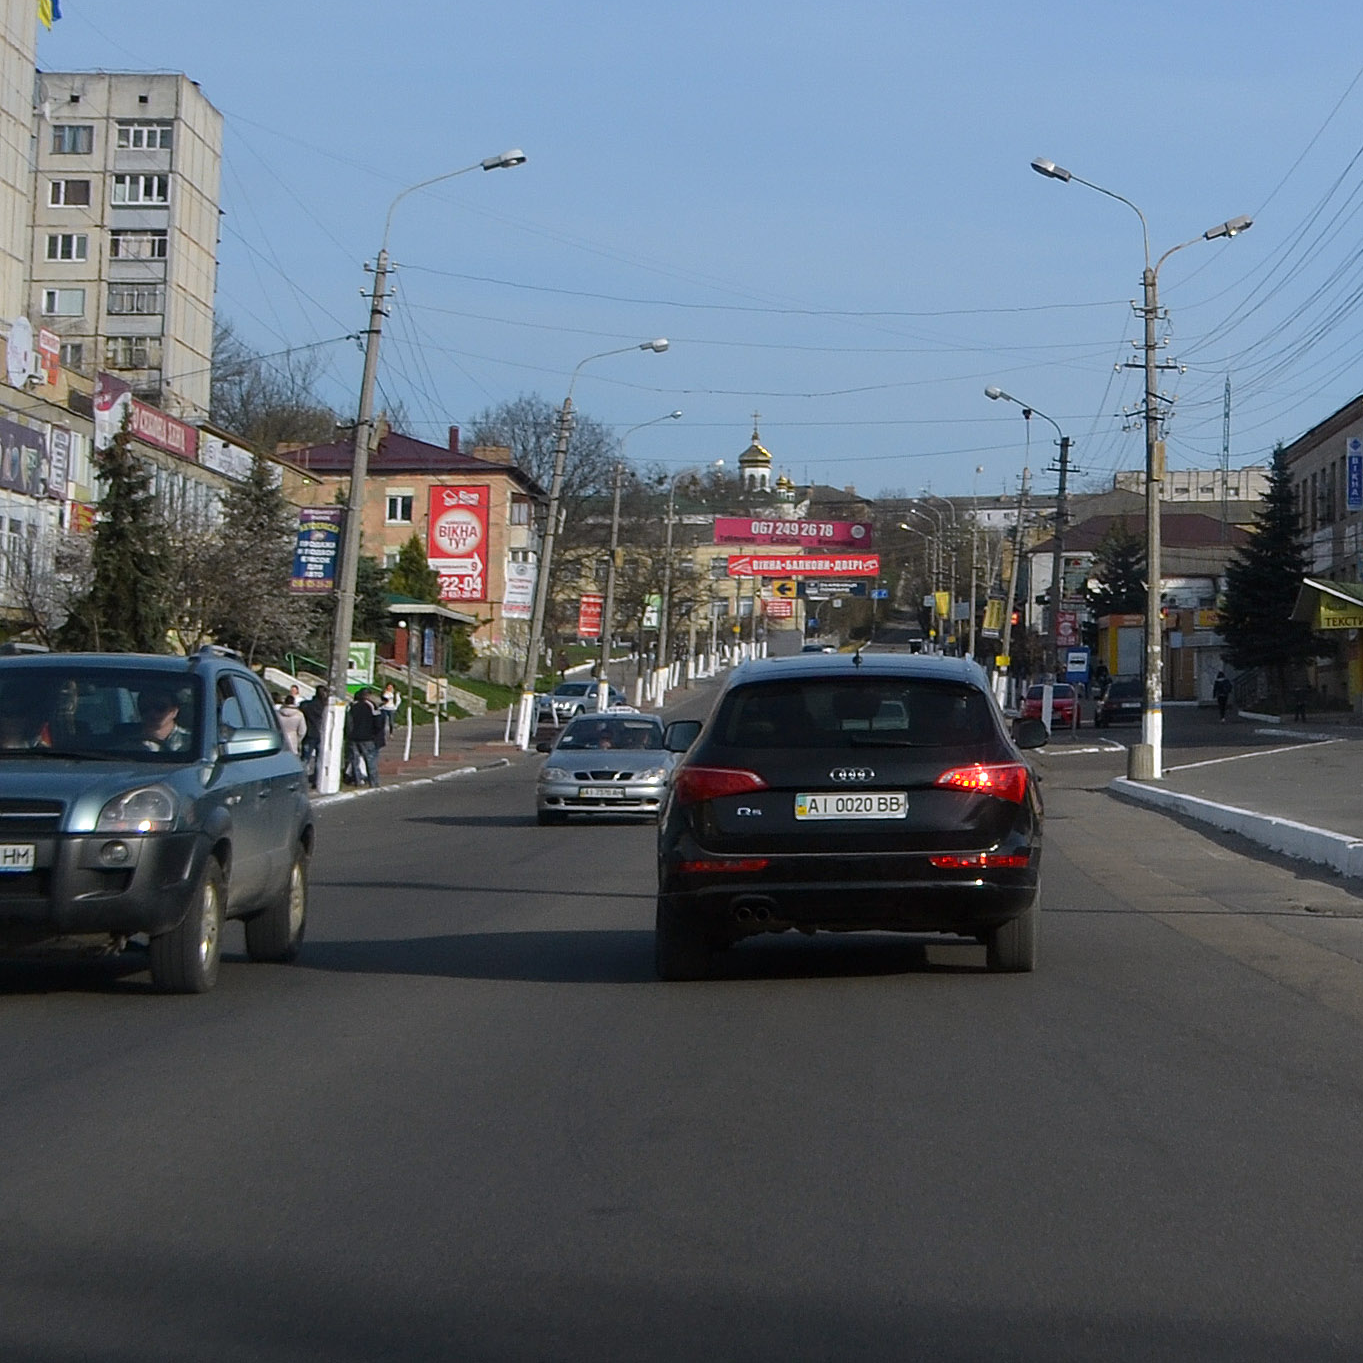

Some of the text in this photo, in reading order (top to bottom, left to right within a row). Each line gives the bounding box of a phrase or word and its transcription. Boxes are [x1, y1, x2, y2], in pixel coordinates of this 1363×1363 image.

[439, 526, 478, 538] ВІКНА
[751, 522, 833, 537] 067 249 26 78
[438, 577, 482, 591] 22-04
[808, 797, 900, 813] AI 0020 BB
[3, 848, 29, 865] HM
